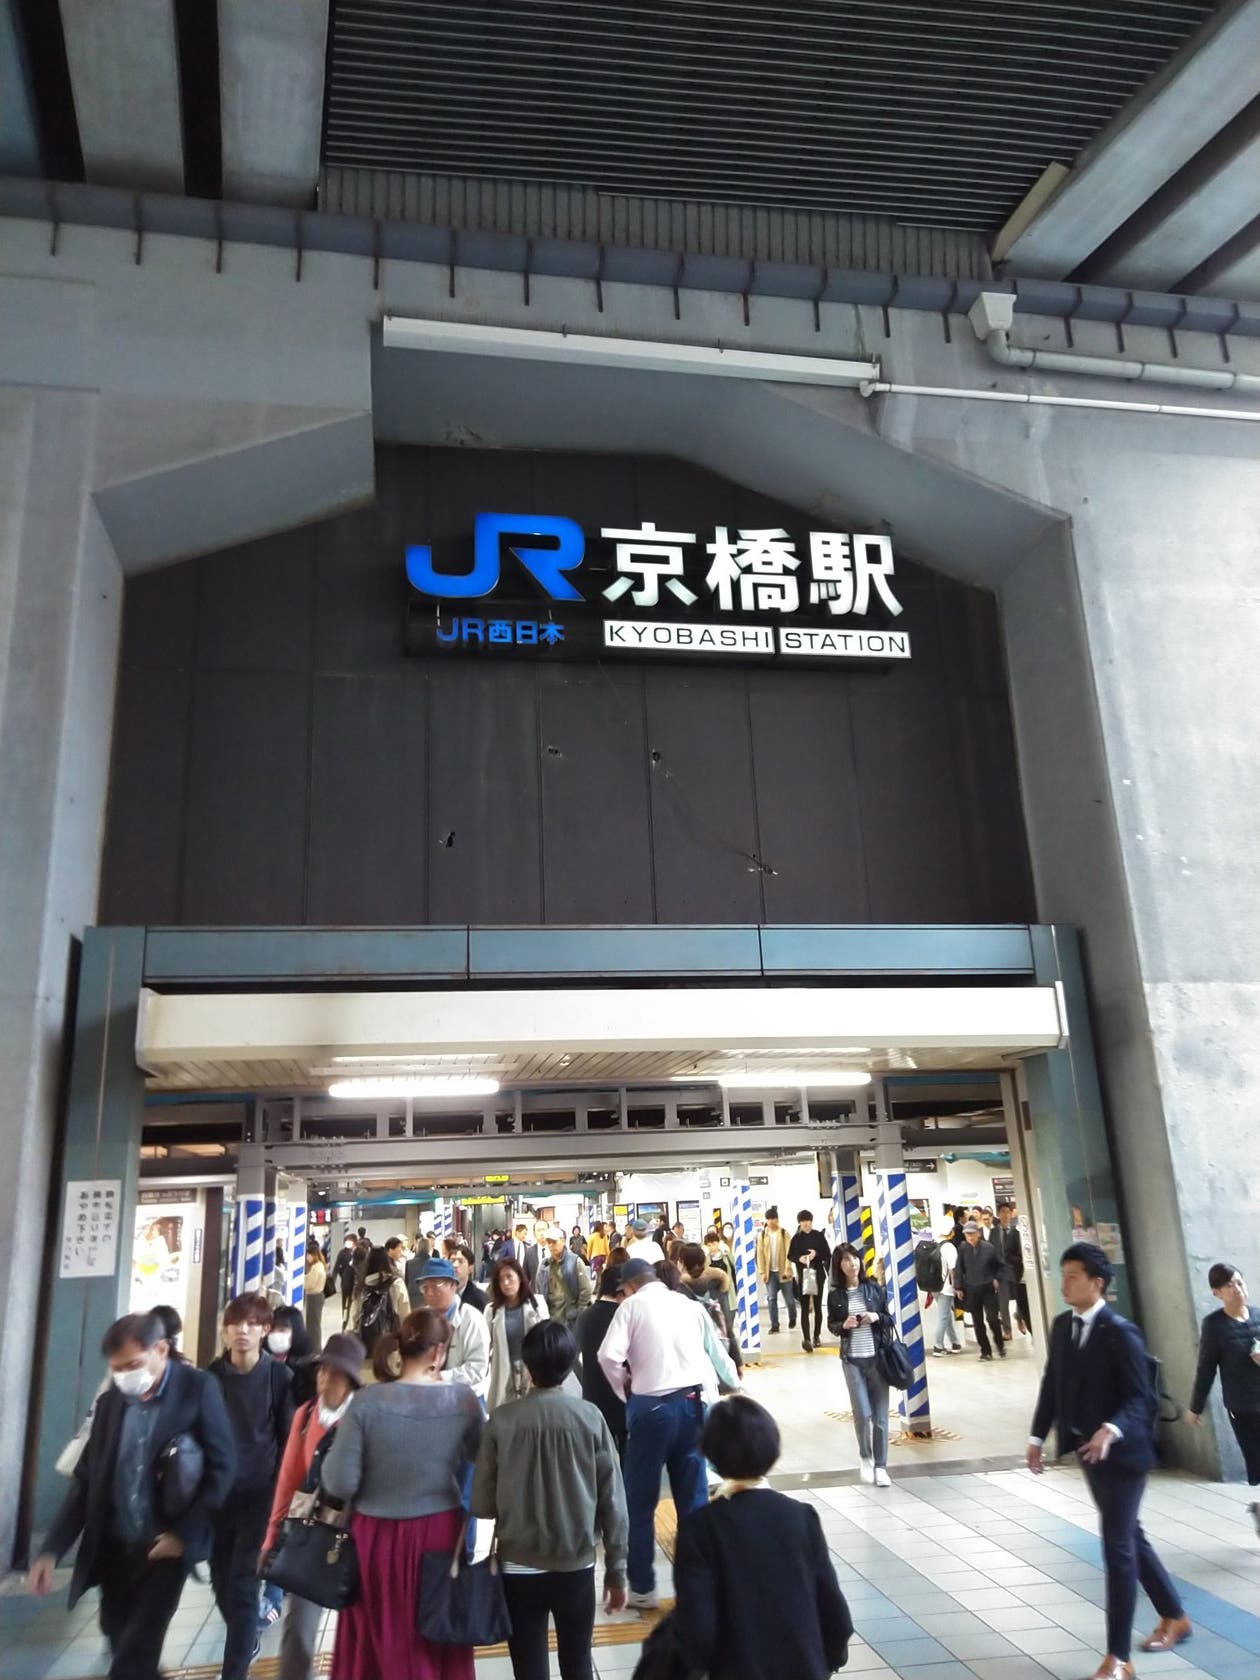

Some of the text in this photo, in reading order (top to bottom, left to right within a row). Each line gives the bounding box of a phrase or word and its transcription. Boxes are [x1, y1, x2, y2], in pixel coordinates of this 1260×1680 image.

[406, 513, 586, 602] JR
[601, 522, 905, 616] 京橋駅
[438, 618, 565, 645] JR西日本
[609, 625, 906, 654] KYOBASHI STATION
